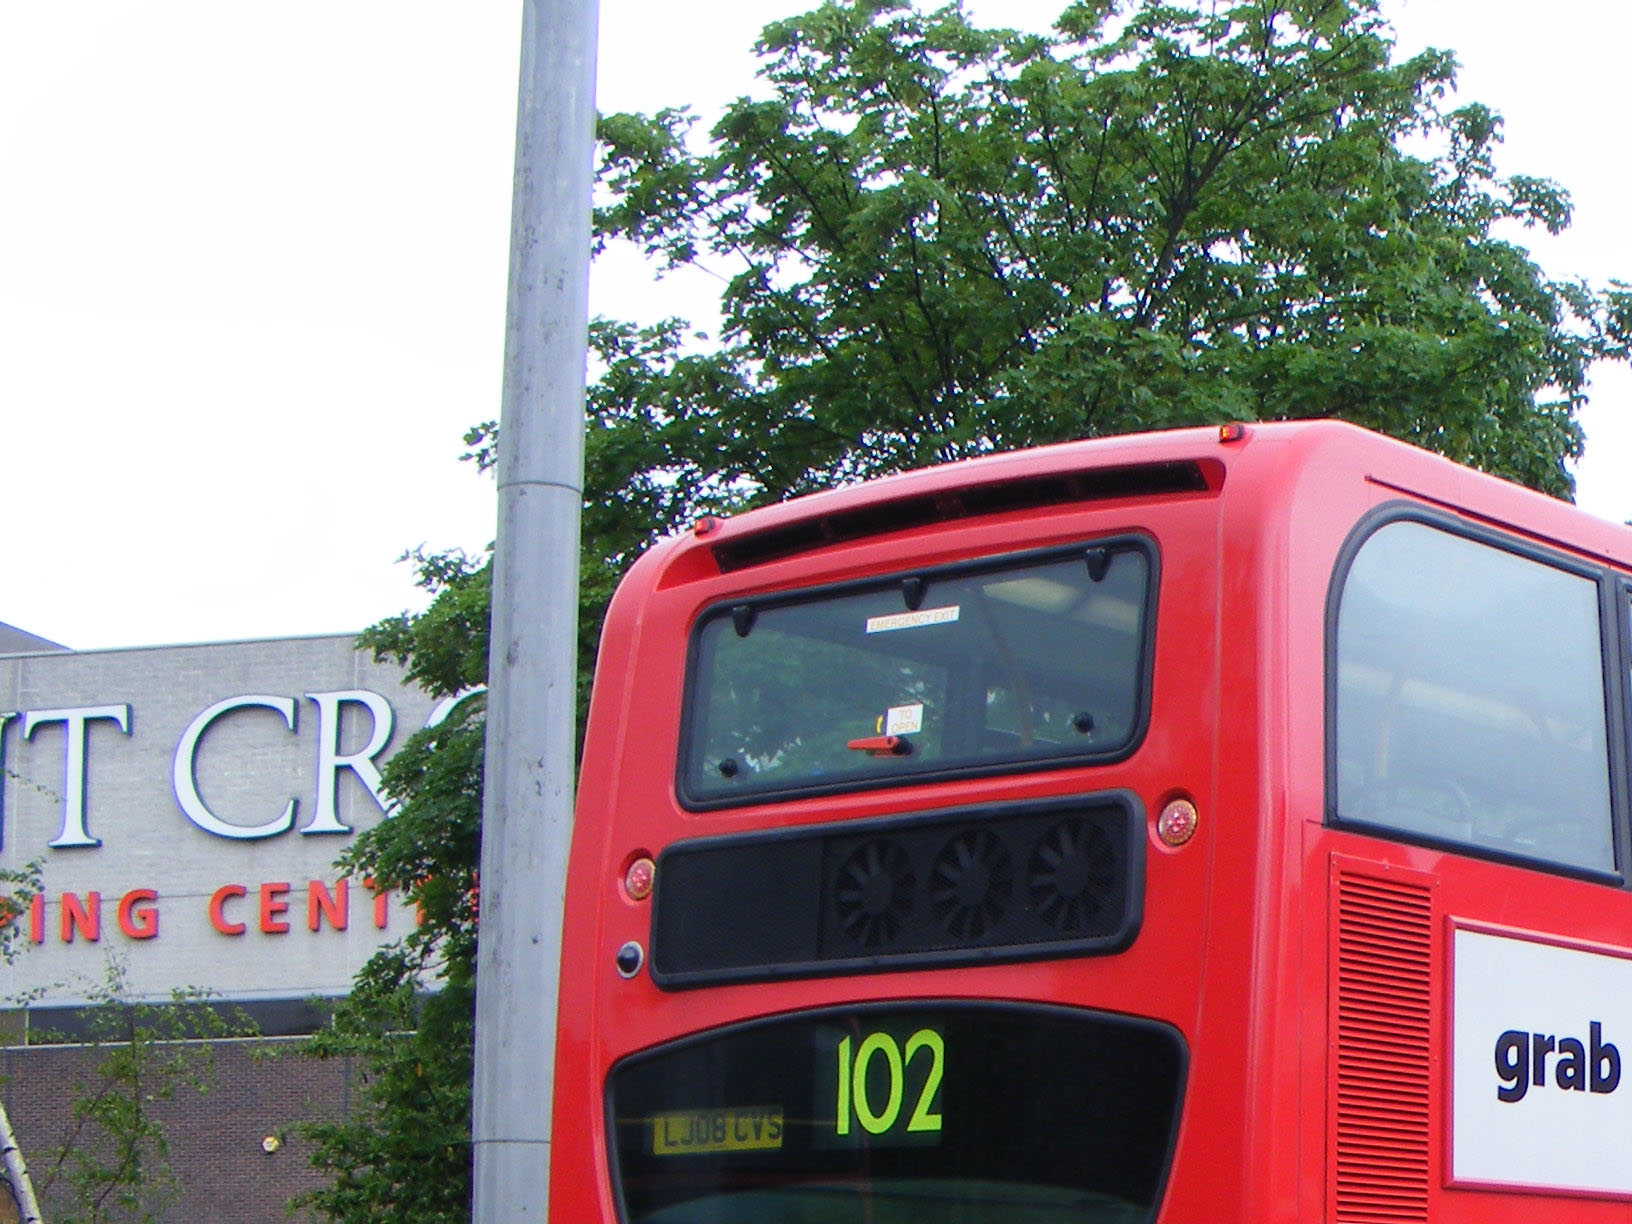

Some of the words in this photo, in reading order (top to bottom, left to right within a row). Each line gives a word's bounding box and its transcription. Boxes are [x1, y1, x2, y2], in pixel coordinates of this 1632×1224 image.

[869, 613, 931, 631] EMERGENCY
[934, 610, 956, 623] EXIT
[0, 704, 133, 850] T
[172, 687, 488, 840] CR
[208, 873, 479, 936] CENT
[837, 1028, 945, 1134] 102
[1495, 1021, 1621, 1103] grab
